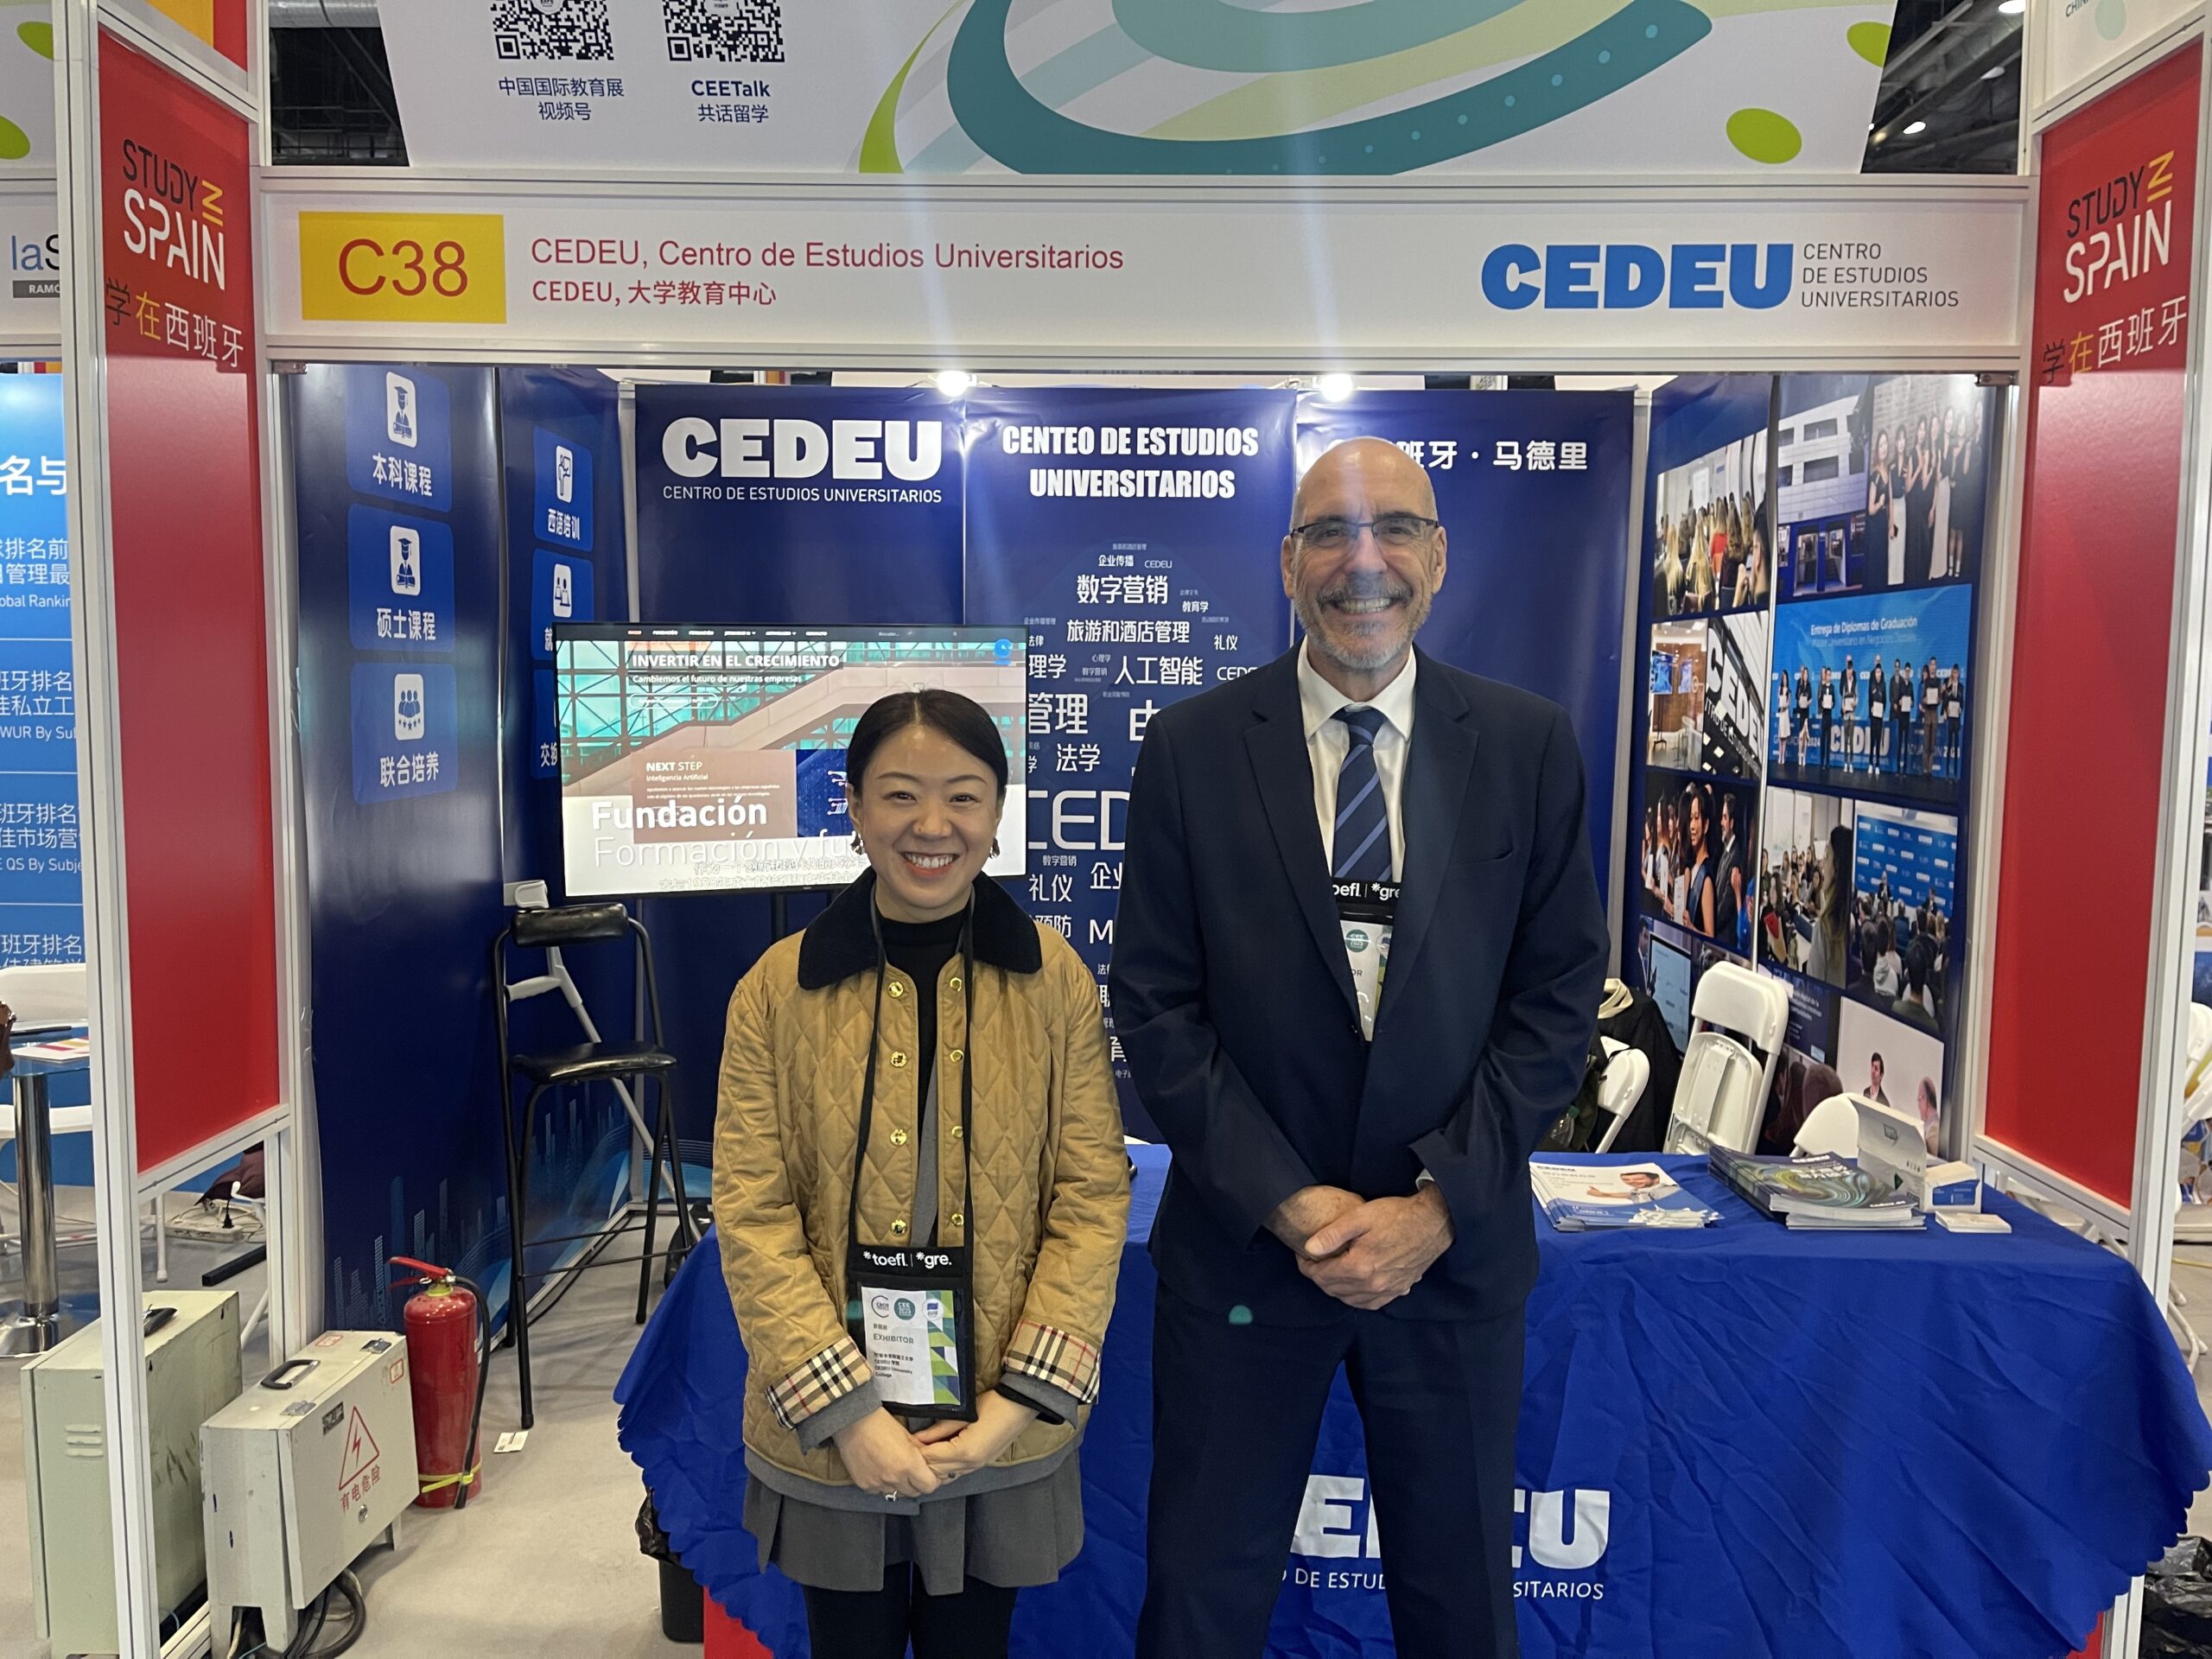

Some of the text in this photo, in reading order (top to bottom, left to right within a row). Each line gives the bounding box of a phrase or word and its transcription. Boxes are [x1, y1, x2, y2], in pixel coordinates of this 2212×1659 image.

[499, 77, 625, 97] 中国国际教育展
[691, 80, 771, 97] CEETalk
[538, 101, 592, 120] 视频号
[698, 104, 768, 123] 共话留学
[123, 138, 198, 212] STUDY
[2067, 165, 2145, 238] STUDY
[124, 188, 225, 290] SPAIN
[1803, 244, 1881, 261] CENTRO
[2063, 200, 2171, 303] SPAIN
[339, 238, 468, 297] C38
[531, 238, 1124, 270] CEDEU, Centro de Estudios Universitarios
[1482, 243, 1794, 310] CEDEU
[1803, 267, 1928, 284] DE ESTUDIOS
[532, 279, 777, 308] CEDEU, 大学教育中心
[1802, 291, 1959, 309] UNIVERSITARIOS
[106, 276, 244, 368] 学在西班牙
[2043, 296, 2186, 385] 学在西班牙
[662, 416, 943, 481] CEDEU
[1002, 425, 1259, 456] CENTEO DE ESTUDIOS
[372, 453, 433, 498] 本科课程
[1030, 468, 1235, 499] UNIVERSITARIOS
[663, 486, 943, 503] CENTRO DE ESTUDIOS UNIVERSITARIOS
[547, 508, 582, 541] 西语培训
[0, 563, 70, 585] 管理最
[1098, 555, 1134, 567] 企业传播
[1077, 575, 1168, 604] 数字营销
[1182, 601, 1209, 613] 教育学
[377, 607, 436, 642] 硕士课程
[1067, 620, 1190, 643] 旅游和酒店管理
[1810, 616, 1917, 637] Entrega de Diplomas de Graduación
[1214, 634, 1238, 651] 礼仪
[632, 654, 840, 668] INVERTIR EN EL CRECIMIENTO
[1115, 656, 1204, 685] 人工智能
[632, 675, 680, 683] Cambiemos
[682, 675, 690, 683] el
[690, 675, 715, 683] futuro
[764, 676, 802, 684] empresas
[1029, 692, 1088, 734] 管理
[35, 726, 52, 741] By
[1830, 725, 1890, 756] CDU
[379, 751, 440, 787] 联合培养
[646, 761, 702, 772] NEXT STEP
[1056, 743, 1100, 772] 法学
[591, 796, 767, 830] Fundación
[0, 827, 80, 849] 佳市场营
[594, 831, 779, 868] Formación
[6, 857, 25, 871] QS
[29, 858, 45, 874] By
[1042, 855, 1077, 867] 数字营销
[1028, 874, 1072, 902] 礼仪
[874, 1333, 914, 1344] EXHIBITOR
[340, 1465, 380, 1512] 有电危险
[1295, 1568, 1319, 1588] DE
